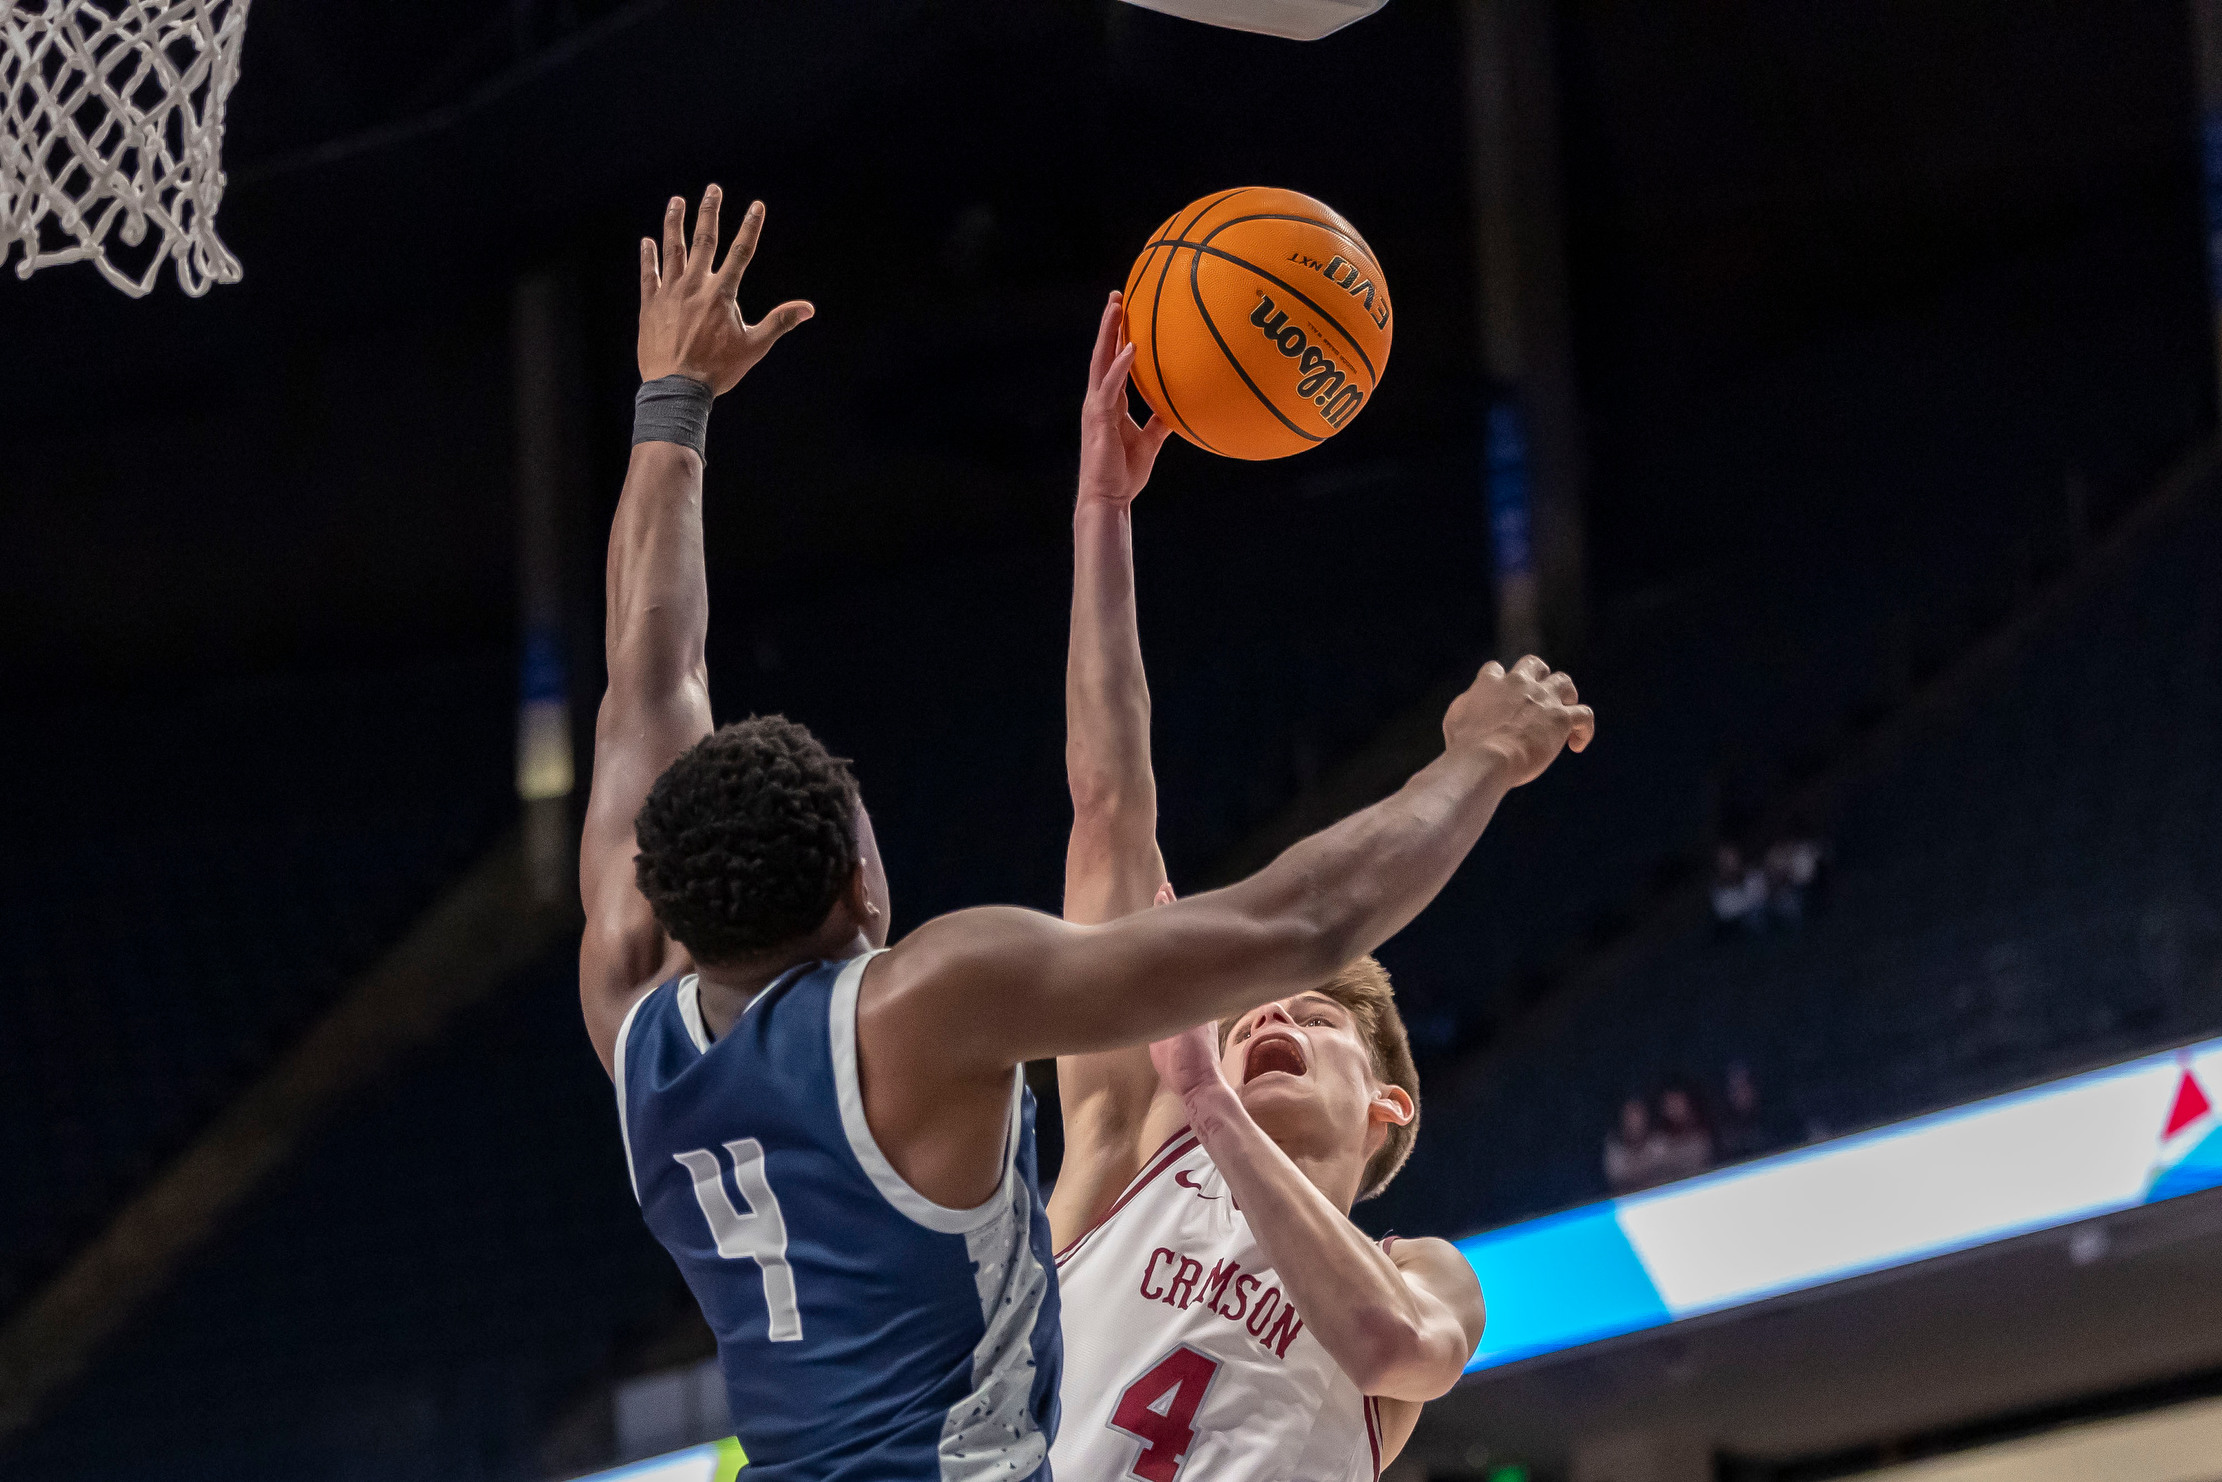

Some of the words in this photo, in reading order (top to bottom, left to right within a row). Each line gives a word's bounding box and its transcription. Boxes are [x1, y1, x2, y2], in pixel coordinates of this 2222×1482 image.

[1287, 252, 1322, 271] NXT
[1323, 254, 1390, 330] EVO
[1249, 293, 1364, 429] Wilson
[673, 1137, 803, 1342] 4
[1105, 1341, 1224, 1482] 4
